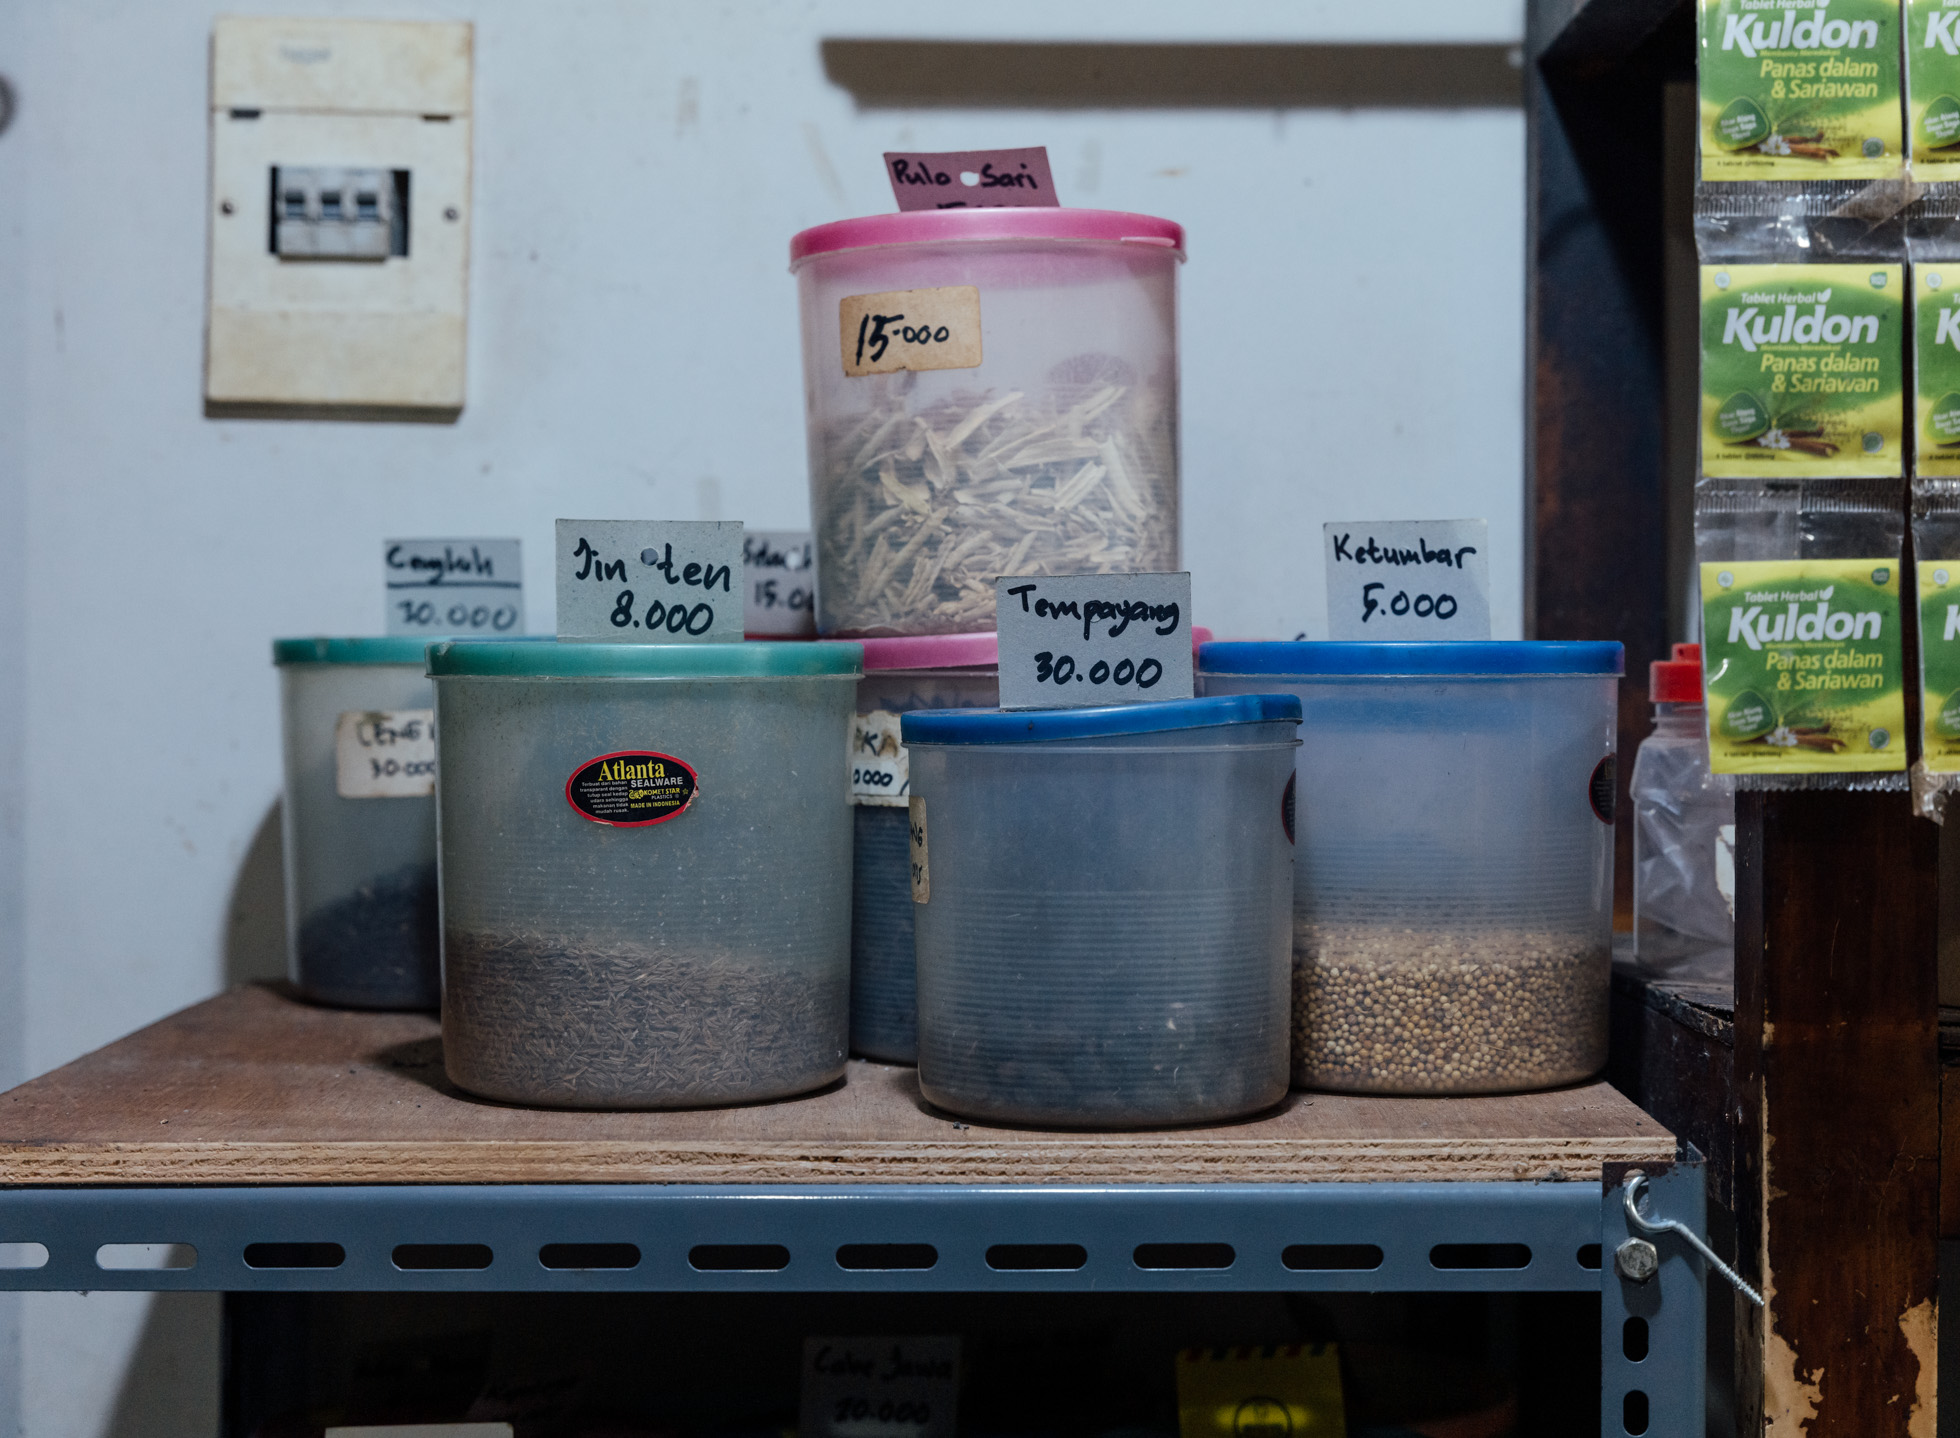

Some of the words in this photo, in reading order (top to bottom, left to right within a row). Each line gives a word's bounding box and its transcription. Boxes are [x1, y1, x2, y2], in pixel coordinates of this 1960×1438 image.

[1722, 9, 1878, 58] Kuldon
[1760, 59, 1816, 78] Panas
[1819, 57, 1879, 77] dalam
[1771, 80, 1786, 98] &
[1789, 78, 1878, 98] Sariawan
[892, 159, 952, 186] Pulo
[981, 163, 1038, 189] Sari
[1741, 292, 1776, 303] Tablet
[1777, 292, 1816, 303] Herbal
[1722, 305, 1879, 352] Kuldon
[1760, 353, 1817, 372] Panas
[1820, 352, 1879, 372] dalam
[1771, 373, 1786, 392] &
[1789, 372, 1879, 392] Sariawan
[1333, 533, 1476, 569] Ketumbar
[1362, 583, 1458, 623] 5.000
[1744, 591, 1778, 602] Tablet
[1780, 590, 1818, 601] Herbal
[610, 589, 714, 635] 8.000
[1007, 584, 1180, 640] Tempayang
[1727, 602, 1882, 650] Kuldon
[1034, 651, 1163, 688] 30.000
[1766, 652, 1820, 670] Panas
[1823, 648, 1883, 669] dalam
[1777, 672, 1791, 690] &
[1794, 670, 1883, 690] Sariawan
[598, 760, 665, 781] Atlanta
[631, 777, 683, 788] SEALWARE
